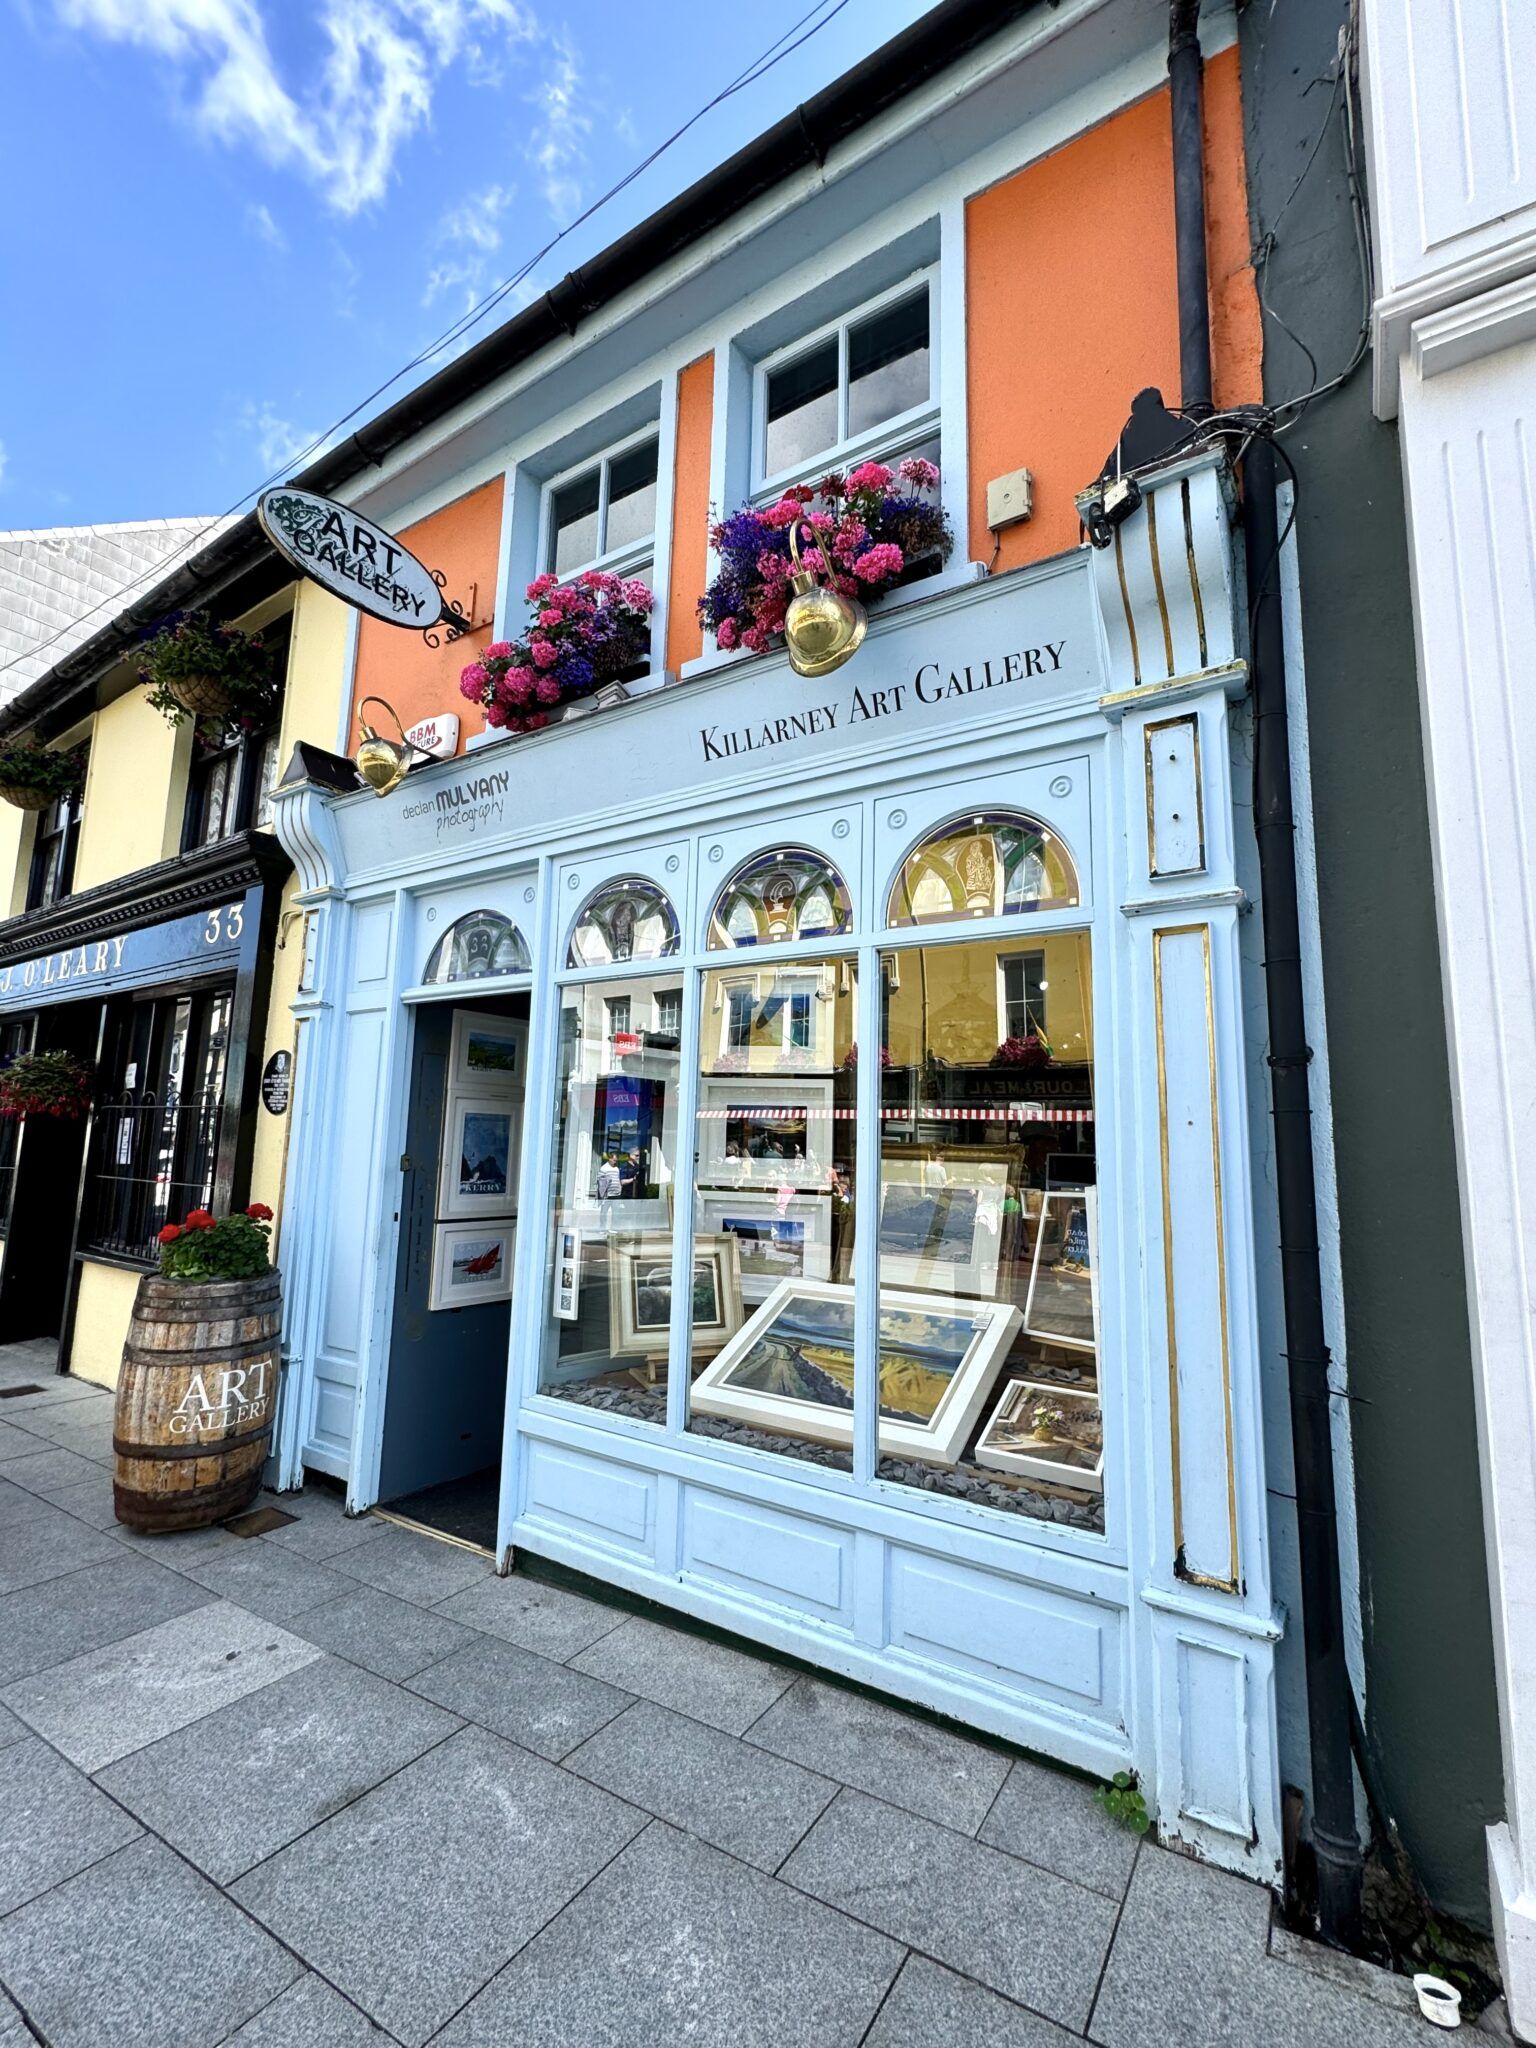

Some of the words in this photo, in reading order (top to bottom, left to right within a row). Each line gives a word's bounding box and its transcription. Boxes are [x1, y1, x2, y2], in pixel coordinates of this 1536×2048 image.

[320, 511, 402, 575] ART
[293, 528, 426, 617] GALLERY
[699, 703, 838, 762] KILLARNEY
[848, 685, 906, 725] ART
[915, 640, 1068, 704] GALLERY
[410, 722, 436, 743] BBM
[416, 736, 435, 748] CURE
[402, 800, 436, 820] declan
[435, 770, 509, 812] MULVANY
[436, 799, 504, 838] photography
[205, 903, 244, 944] 33
[24, 935, 129, 988] O'LEARY
[470, 935, 488, 954] 33
[465, 1182, 502, 1192] KERRY
[172, 1359, 273, 1414] ART
[169, 1396, 271, 1434] GALLERY
